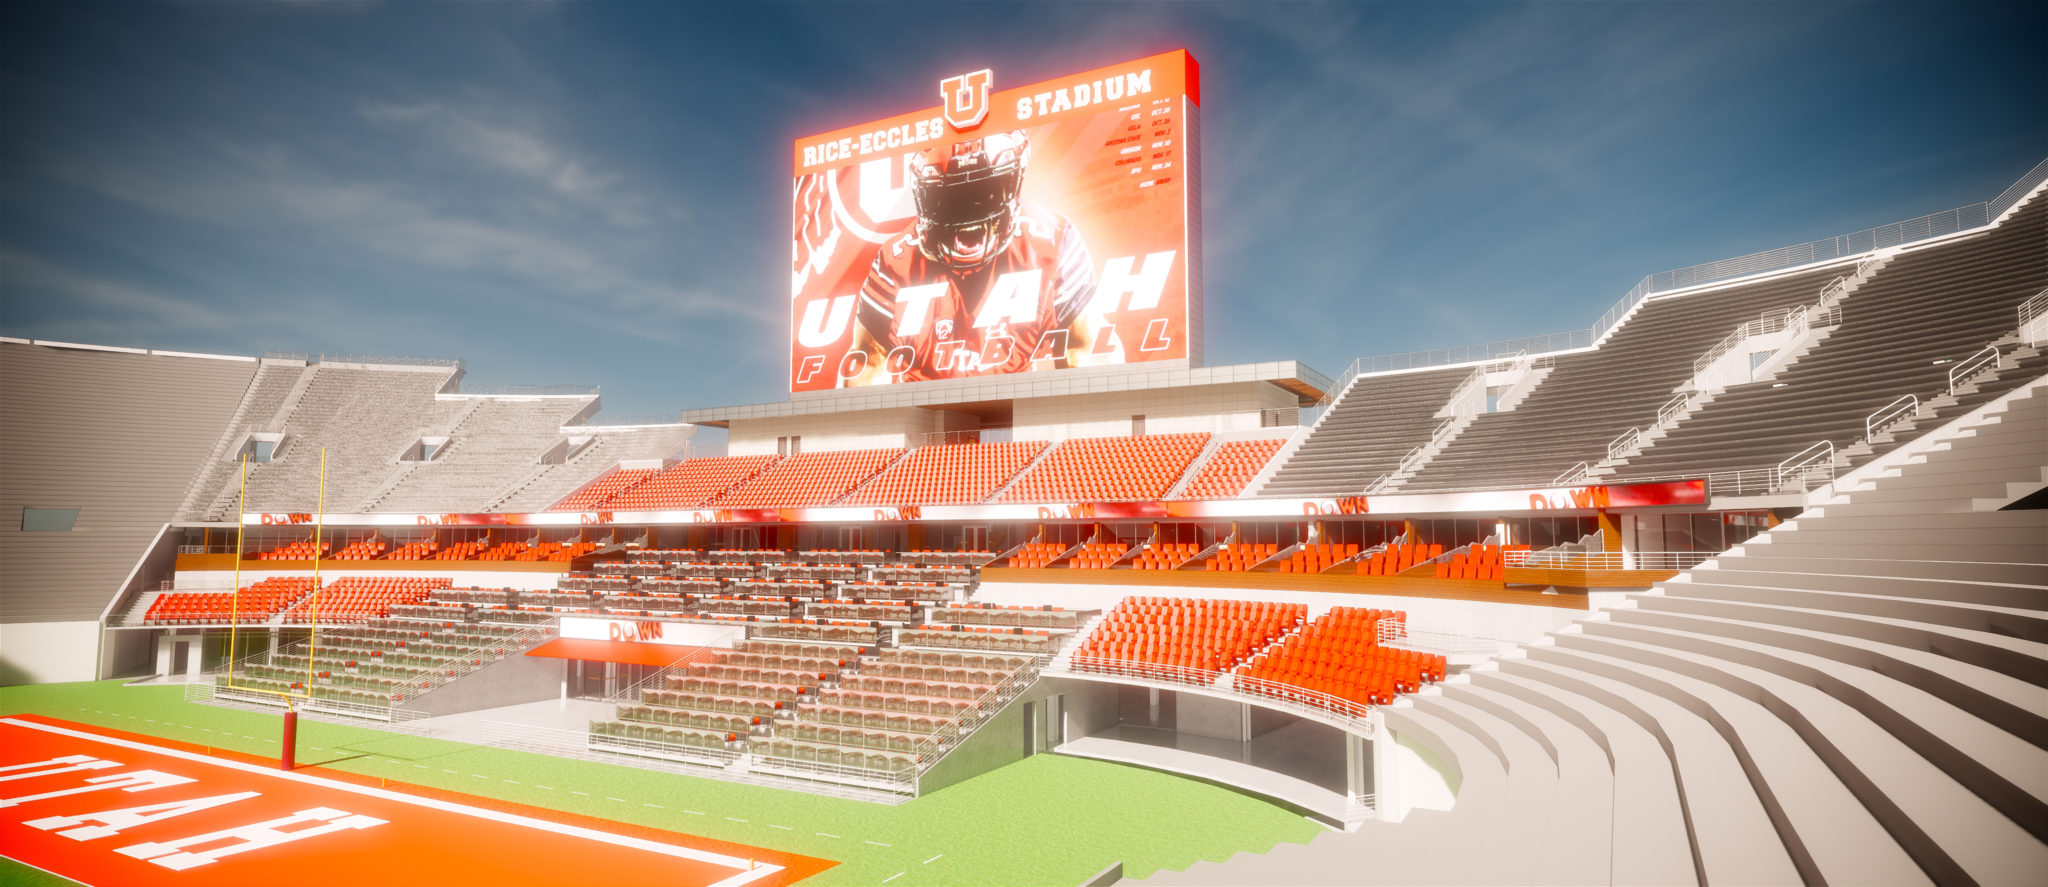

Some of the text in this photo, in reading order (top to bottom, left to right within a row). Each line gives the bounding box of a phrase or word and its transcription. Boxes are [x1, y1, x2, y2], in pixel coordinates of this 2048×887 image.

[940, 68, 993, 129] U
[803, 69, 1152, 167] RICE-ECCLES STADIUM
[798, 250, 1177, 348] UTAH
[797, 318, 1171, 383] FOOTBALL
[1303, 496, 1369, 516] DOWN
[1529, 486, 1610, 510] DOWN
[260, 513, 312, 526] DOWN
[873, 505, 922, 521] DOWN
[1038, 503, 1095, 519] DOWN
[609, 620, 663, 642] DOWN
